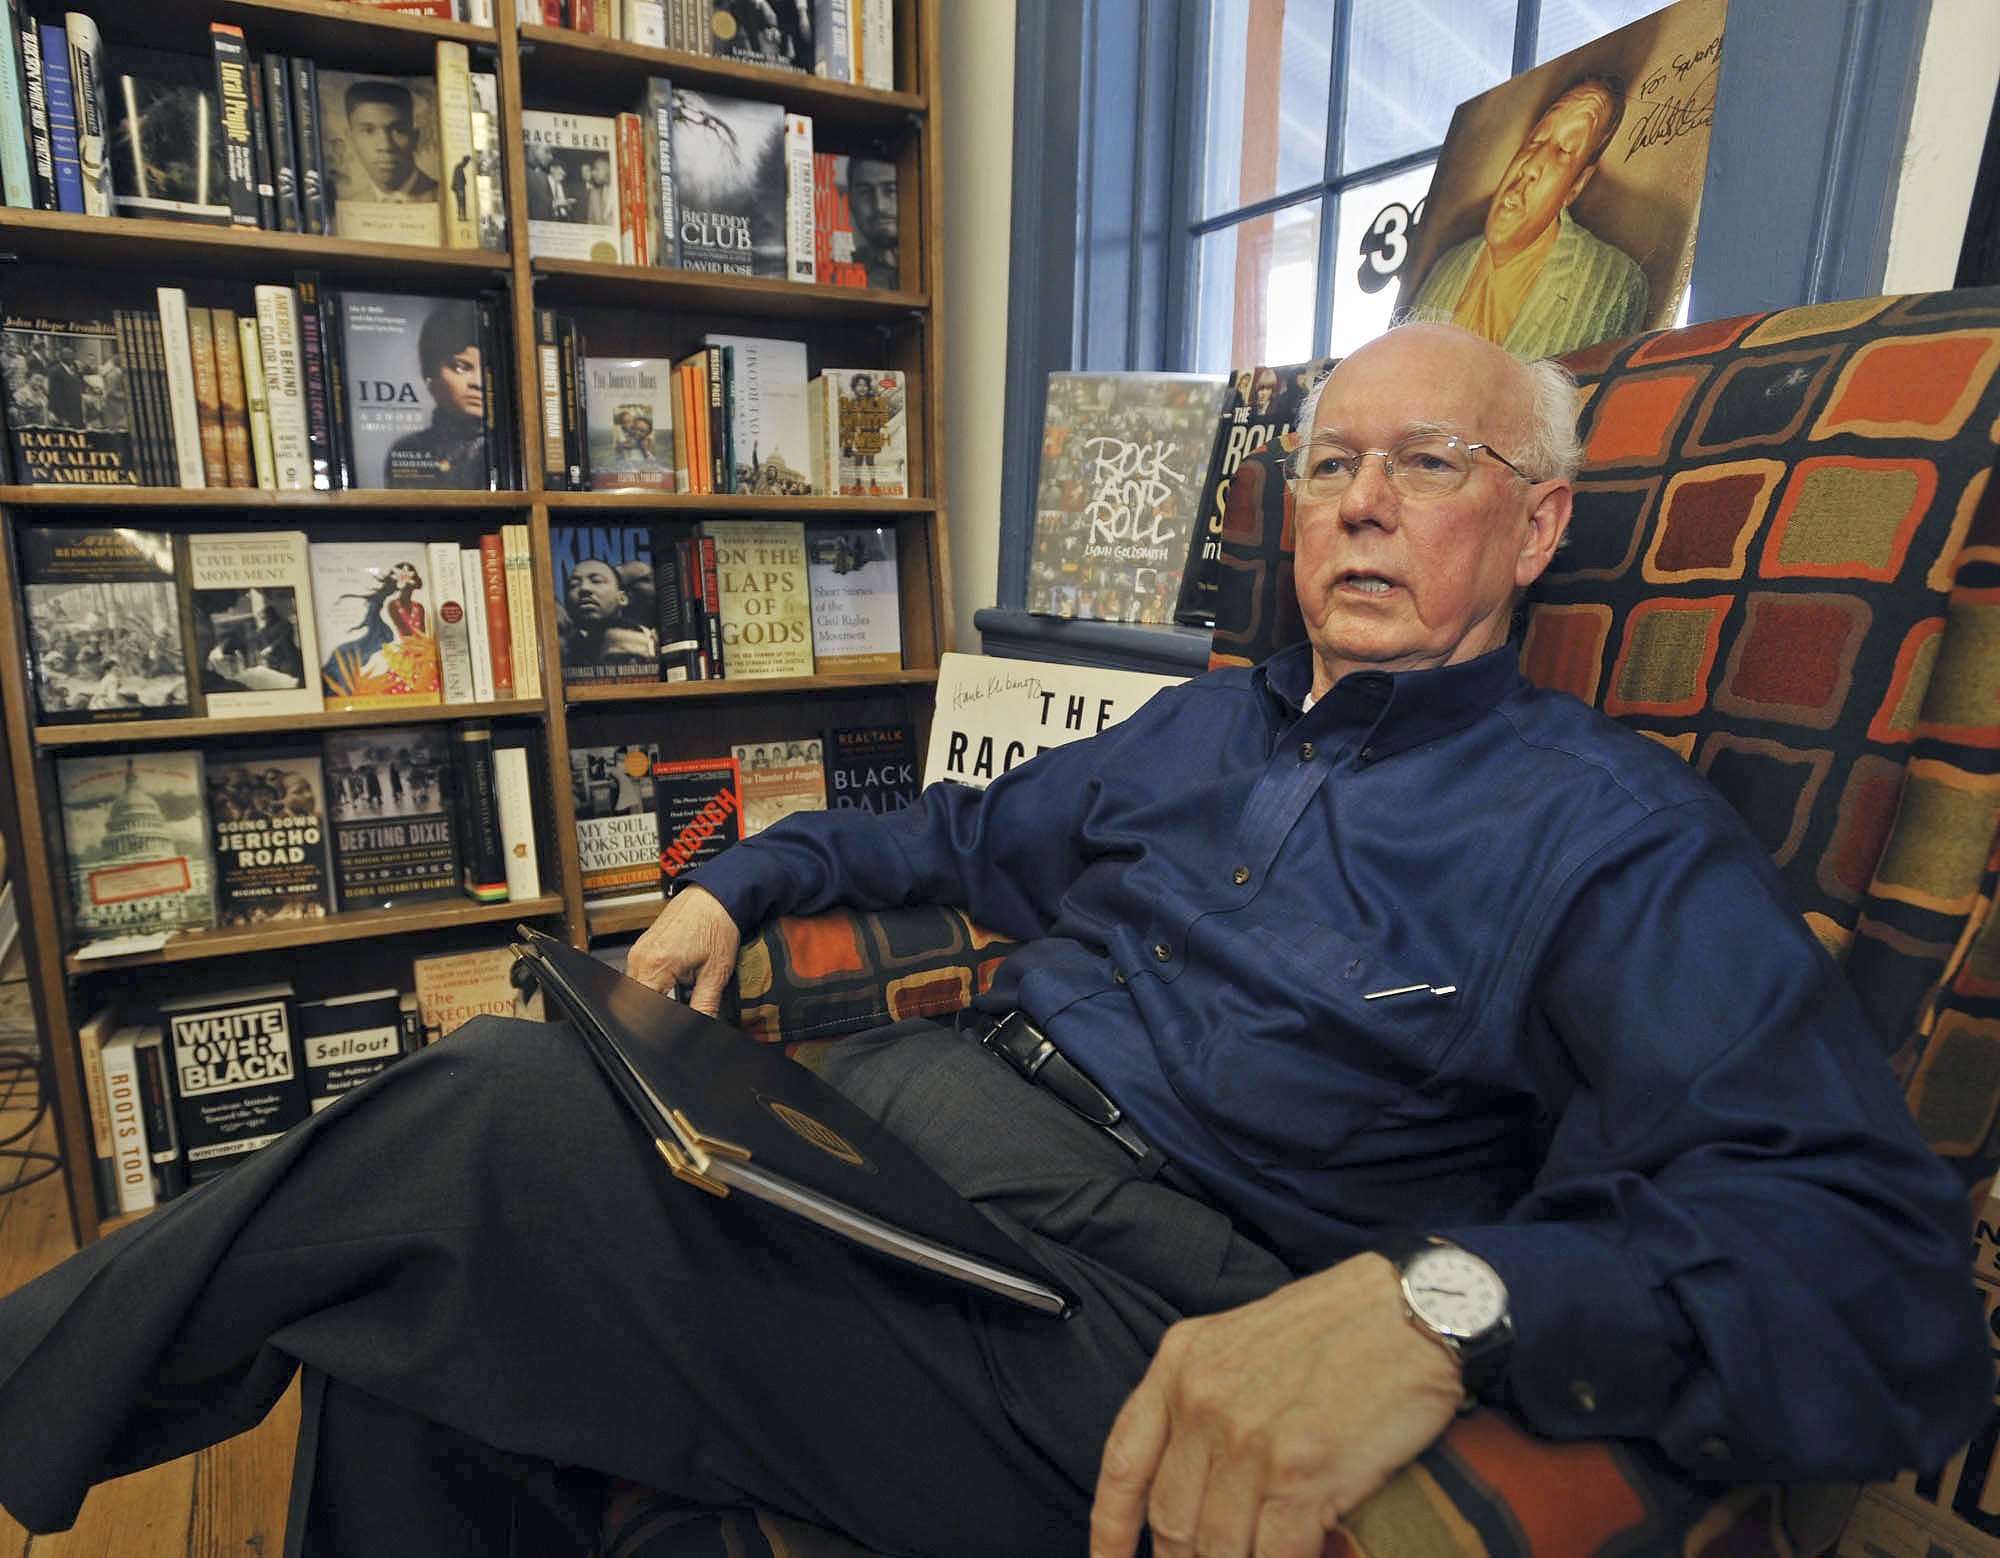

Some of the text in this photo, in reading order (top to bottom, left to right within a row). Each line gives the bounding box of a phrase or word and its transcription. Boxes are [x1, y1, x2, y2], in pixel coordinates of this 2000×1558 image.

[220, 62, 248, 99] Local
[221, 98, 251, 142] People
[571, 135, 609, 147] BEAT
[680, 223, 752, 248] CLUB
[260, 325, 279, 369] COLOR
[274, 292, 297, 397] AMERICA BEHIND
[710, 349, 720, 381] MISSING
[264, 369, 280, 393] LINE
[357, 380, 419, 403] IDA
[1234, 407, 1252, 424] THE
[19, 432, 91, 449] RACIAL
[26, 451, 122, 467] EQUALITY
[1084, 437, 1186, 484] ROCK
[52, 469, 139, 483] AMERICA
[1094, 478, 1172, 508] AND
[1084, 500, 1176, 544] ROLL
[196, 553, 296, 567] CIVIL RIGHTS
[550, 527, 653, 592] KING
[716, 549, 801, 565] ON THE
[1113, 546, 1168, 560] GOLDSMITH
[199, 568, 288, 582] MOVEMENT
[724, 571, 795, 593] LAPS
[744, 599, 776, 616] OF
[721, 621, 805, 646] GODS
[1040, 690, 1115, 733] THE
[947, 730, 1052, 779] RAC
[754, 773, 784, 784] Thunder
[834, 764, 913, 790] BLACK
[217, 816, 319, 833] GOING DOWN
[409, 822, 450, 843] DIXIE
[579, 819, 648, 838] MY SOUL
[660, 788, 738, 877] ENOUGH
[218, 828, 321, 851] JERICHO
[578, 836, 619, 854] OOKS
[238, 847, 306, 868] ROAD
[591, 847, 659, 867] WONDER
[424, 992, 455, 1006] The
[425, 1000, 517, 1024] EXECUTION
[177, 1010, 281, 1045] WHITE
[193, 1036, 272, 1064] OVER
[315, 1037, 389, 1059] Sellout
[183, 1053, 288, 1091] BLACK
[110, 1072, 145, 1186] ROOTS TOO
